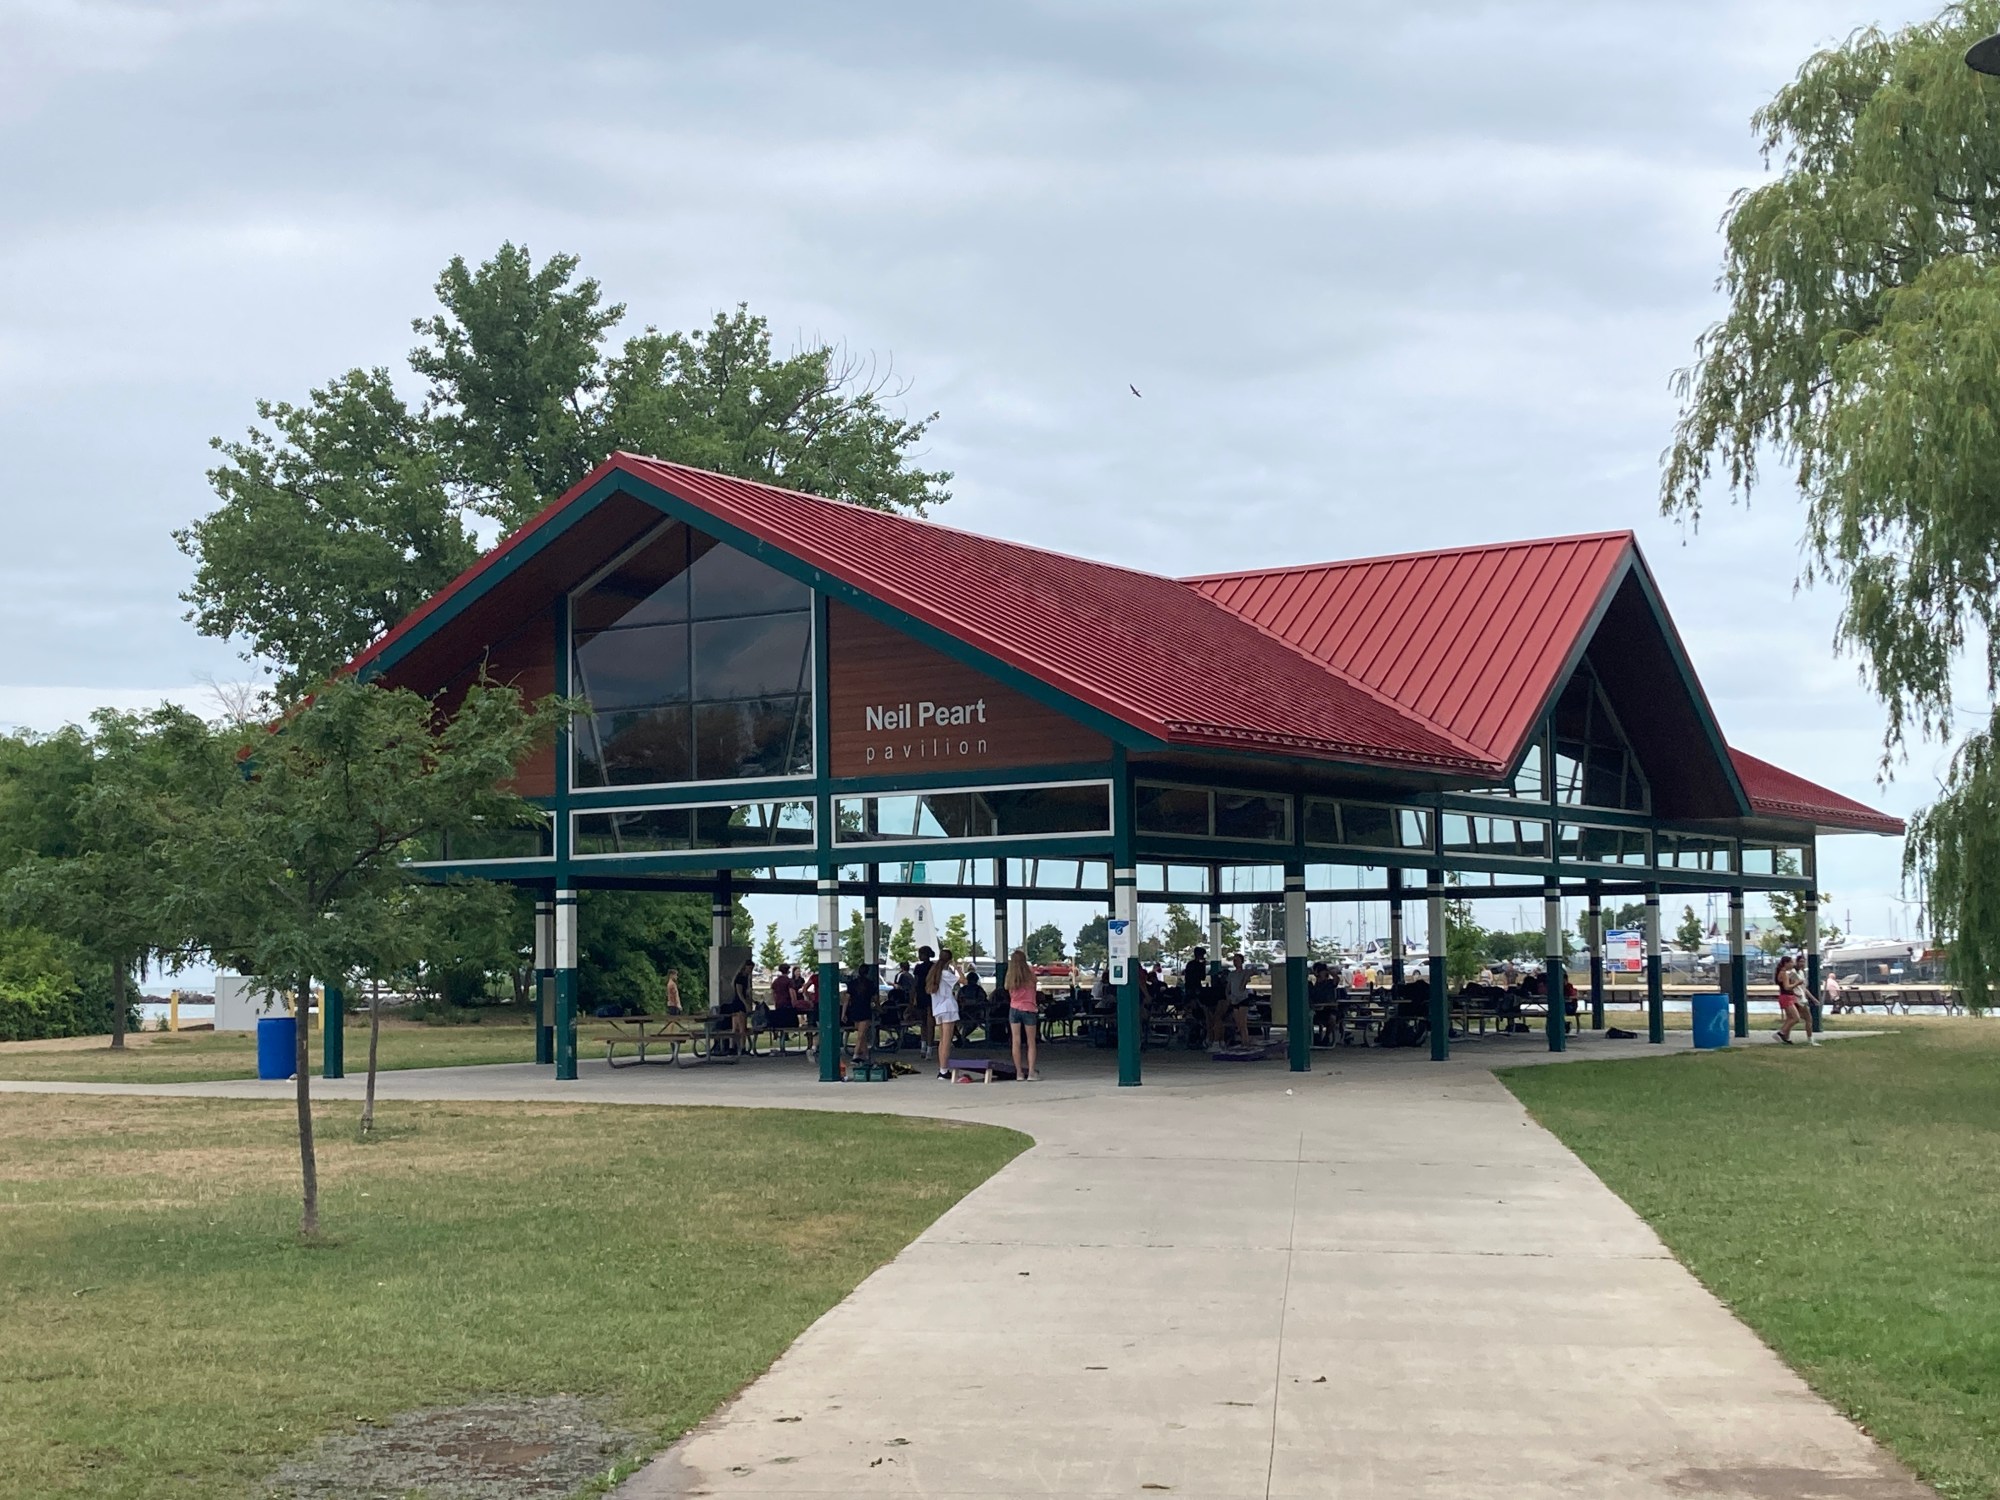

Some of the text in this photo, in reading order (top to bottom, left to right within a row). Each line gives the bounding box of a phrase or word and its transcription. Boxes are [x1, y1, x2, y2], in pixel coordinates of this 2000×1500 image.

[866, 698, 986, 731] Neil Peart
[866, 738, 987, 765] pavilion
